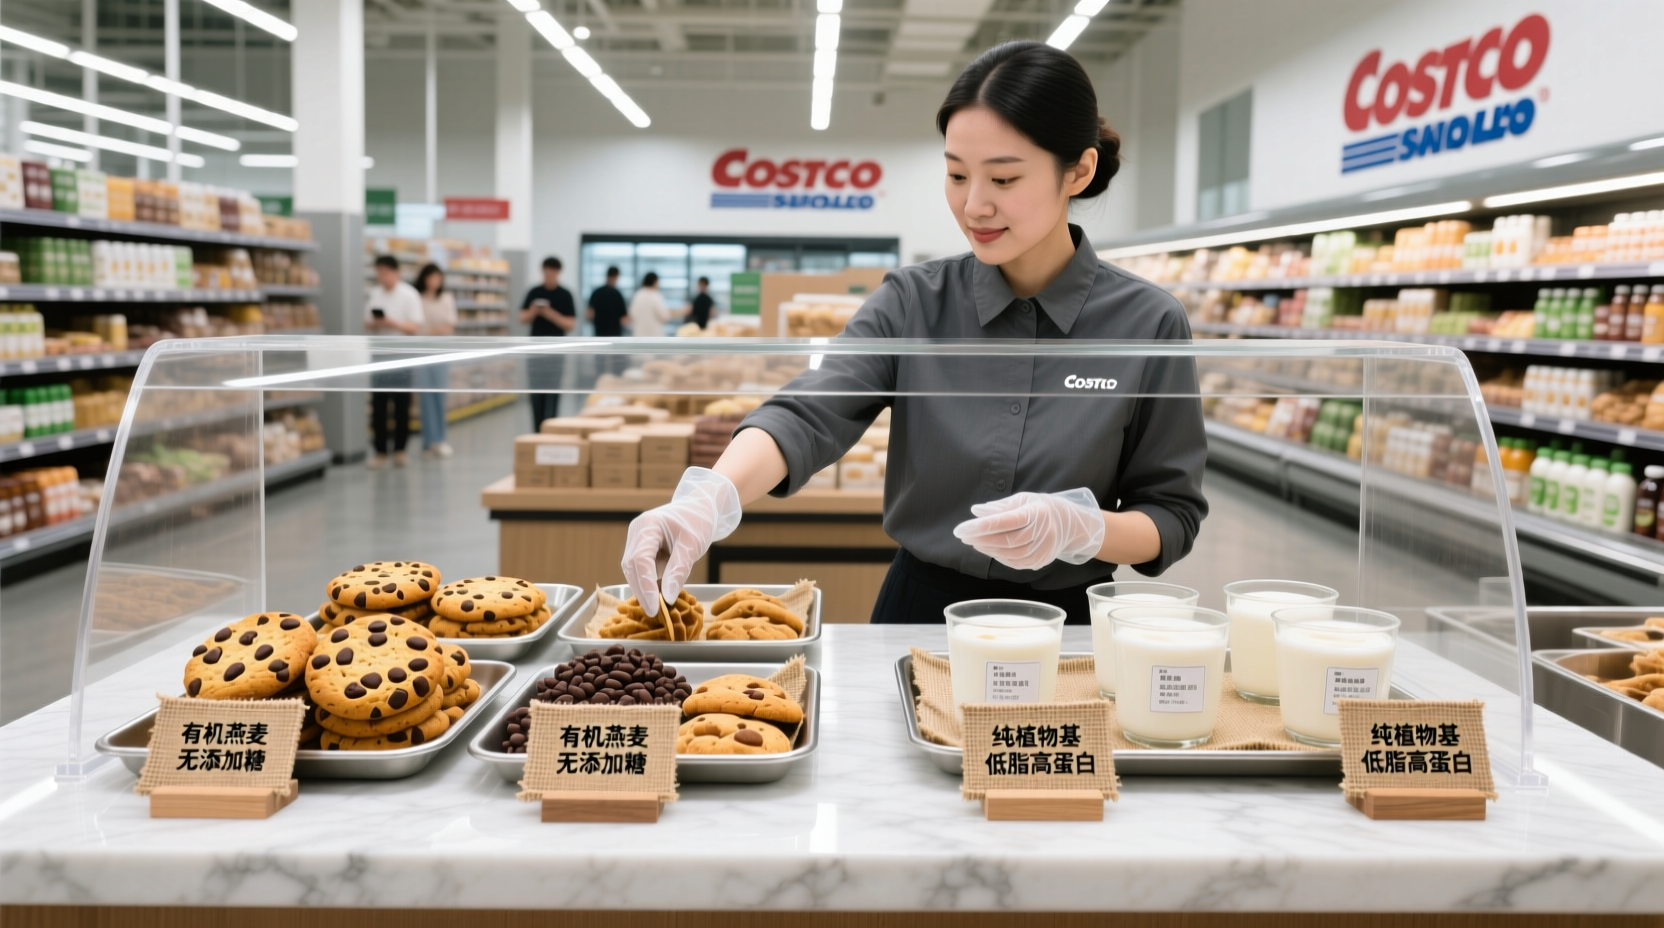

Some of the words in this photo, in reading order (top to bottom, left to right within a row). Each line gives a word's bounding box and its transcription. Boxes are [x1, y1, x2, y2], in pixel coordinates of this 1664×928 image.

[1344, 14, 1550, 131] COSTCO
[711, 149, 882, 189] COSTCO
[181, 722, 268, 745] 有机燕麦
[560, 725, 649, 748] 有机燕麦
[992, 723, 1081, 748] 纯植物基
[1371, 723, 1460, 746] 纯植物基
[176, 748, 266, 772] 无添加糖
[556, 751, 647, 775] 无添加糖
[985, 751, 1095, 775] 低脂高蛋白
[1361, 750, 1472, 774] 低脂高蛋白
